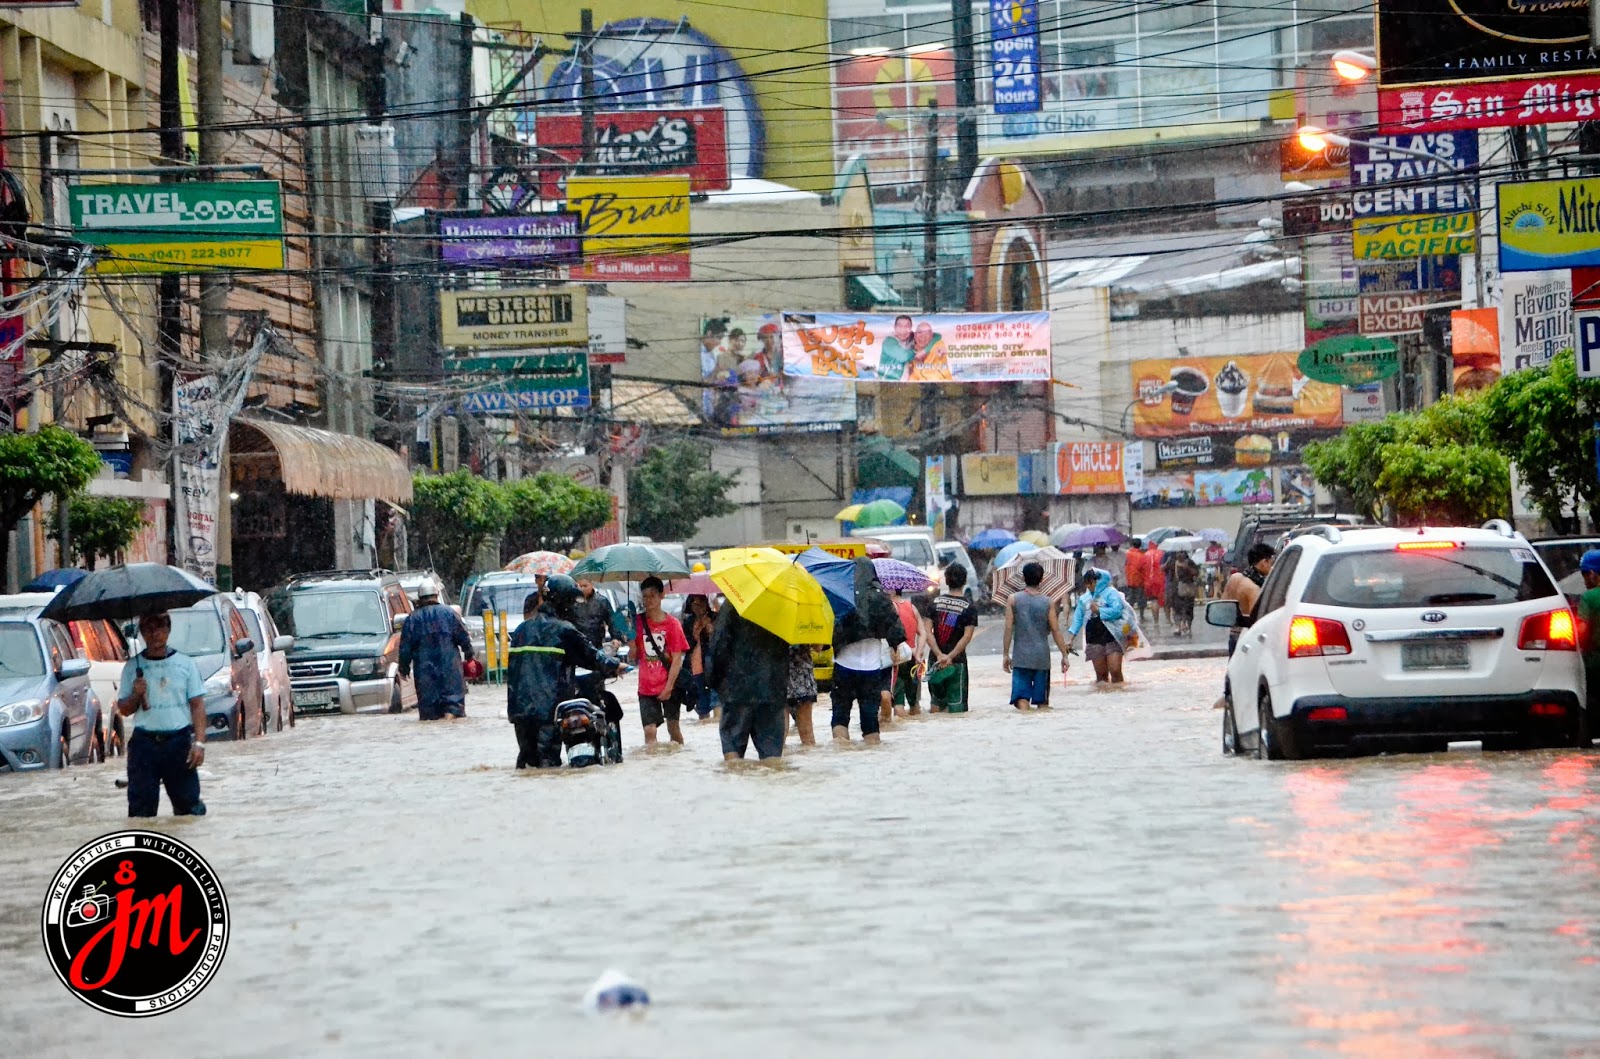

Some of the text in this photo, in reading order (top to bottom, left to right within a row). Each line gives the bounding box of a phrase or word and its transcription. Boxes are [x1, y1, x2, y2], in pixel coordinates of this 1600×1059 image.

[994, 37, 1034, 54] open
[1458, 54, 1528, 69] FAMILY
[995, 55, 1036, 88] 24
[995, 90, 1036, 104] hours
[1430, 82, 1600, 122] San Mig
[1045, 114, 1096, 132] Globe
[1368, 133, 1456, 162] ELA'S
[1353, 187, 1476, 214] CENTER
[1502, 201, 1559, 229] Mitchi SUN
[1396, 215, 1469, 236] CEBU
[191, 247, 252, 260] 222-8077
[1364, 234, 1475, 259] PACIFIC
[597, 262, 618, 273] San
[619, 261, 656, 275] Miguel
[1525, 283, 1552, 299] Where
[458, 296, 553, 312] WESTERN
[1514, 291, 1567, 317] Flavors
[488, 309, 553, 324] UNION
[472, 327, 570, 340] MONEY TRANSFER
[796, 319, 875, 353] Laugh
[956, 323, 992, 331] OCTOBER
[817, 344, 865, 362] Out
[1520, 341, 1544, 354] meets
[1071, 442, 1113, 472] CIRCLE
